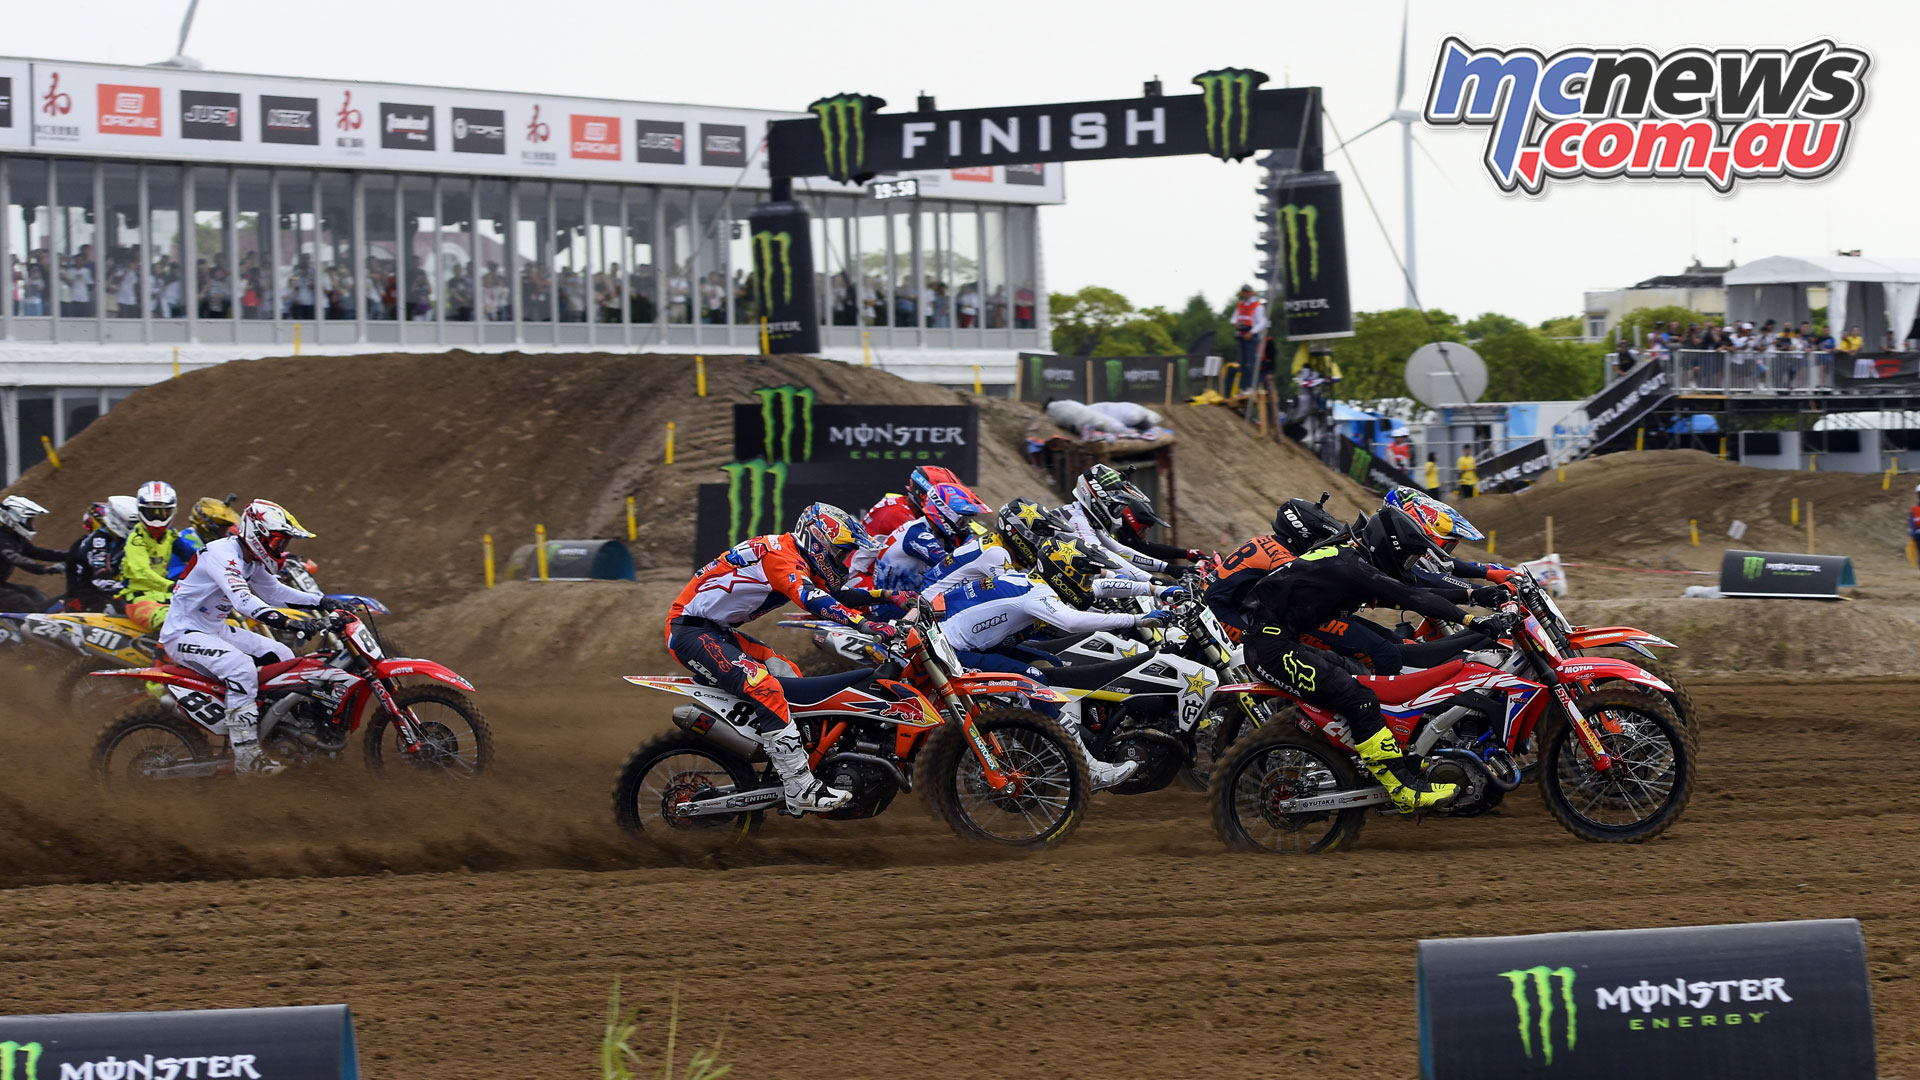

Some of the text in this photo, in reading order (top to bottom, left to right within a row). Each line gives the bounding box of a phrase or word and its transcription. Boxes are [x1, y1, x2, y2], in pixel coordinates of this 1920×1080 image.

[902, 107, 1166, 159] FINISH
[1639, 372, 1667, 396] OUT
[829, 423, 966, 446] MONSTER
[851, 451, 946, 460] ENERGY
[1087, 478, 1112, 506] 100%
[1284, 508, 1312, 539] 100%
[1390, 536, 1402, 551] FOX
[86, 628, 122, 650] 311
[178, 643, 231, 657] KENNY
[1256, 664, 1302, 698] HONDA
[1564, 665, 1594, 675] MOTUL
[177, 691, 226, 725] 89
[974, 736, 998, 770] MOTOREX
[1595, 977, 1793, 1013] MONSTER
[1629, 1012, 1766, 1031] ENERGY
[59, 1054, 262, 1080] MONSTER
